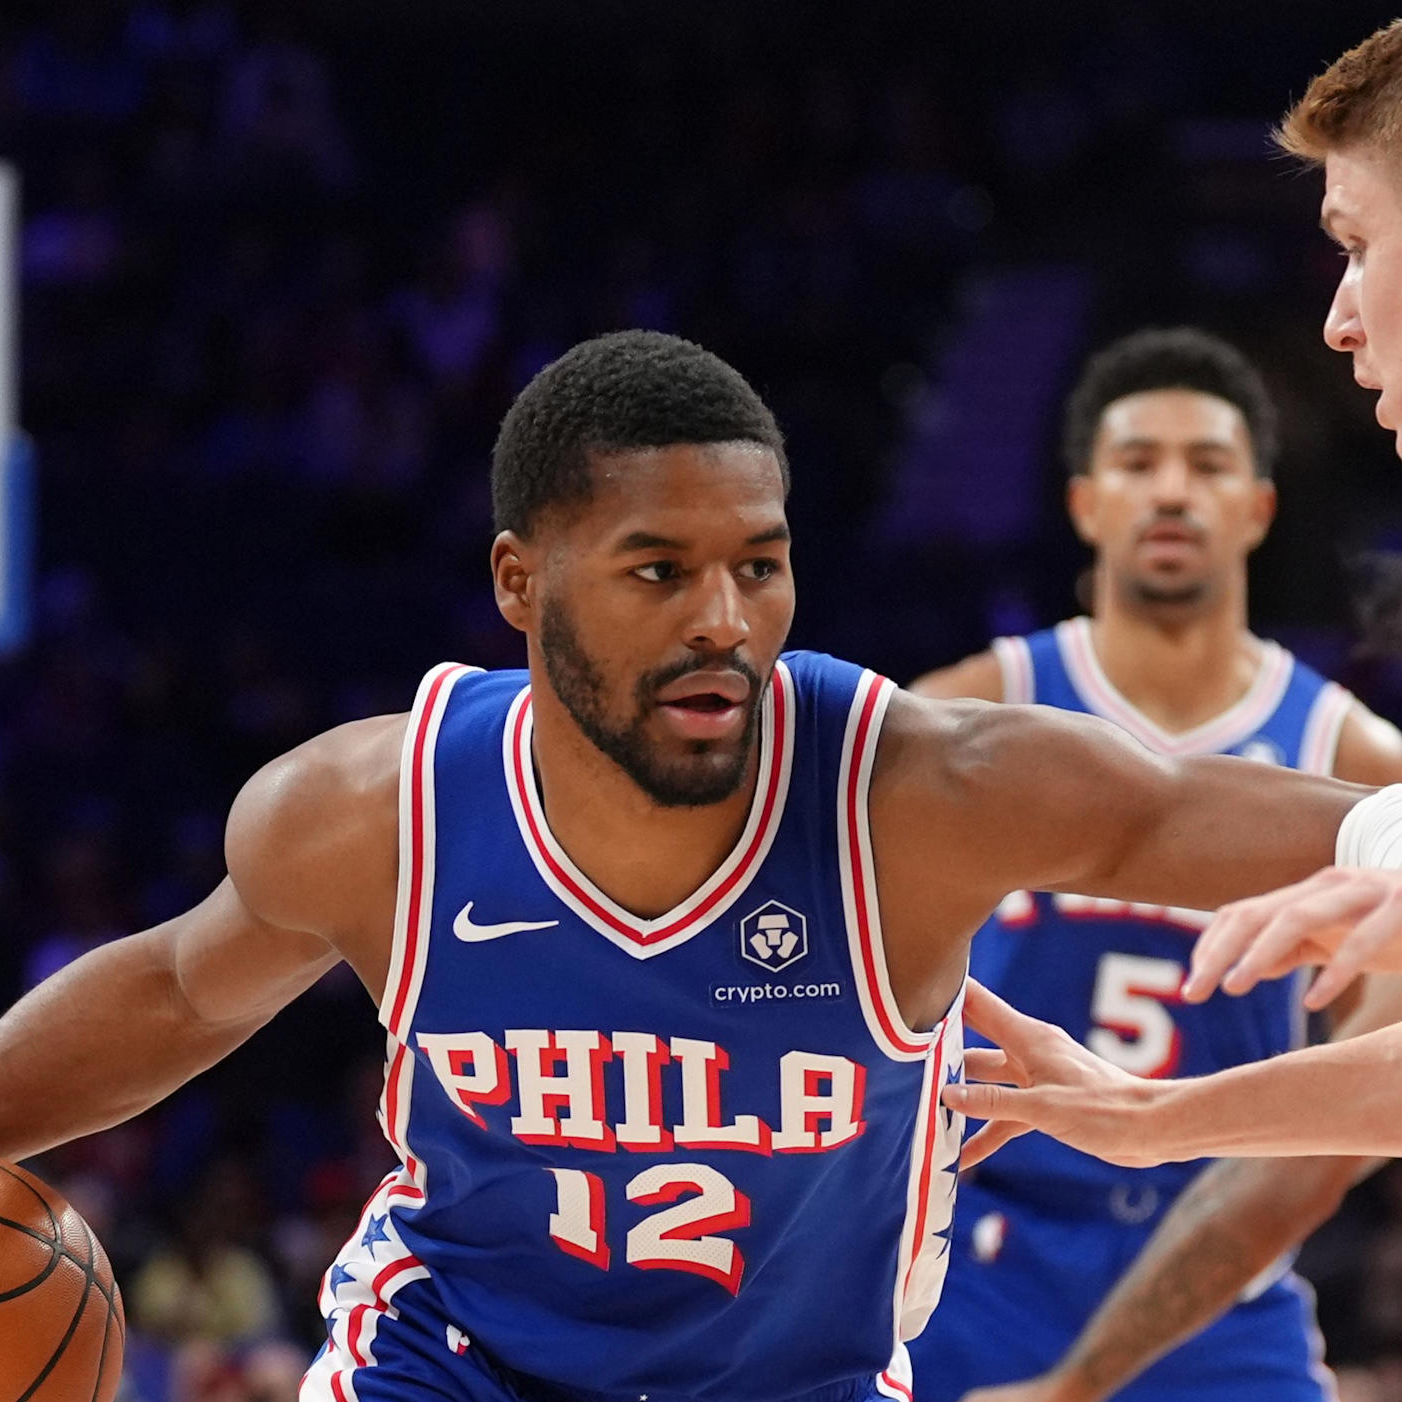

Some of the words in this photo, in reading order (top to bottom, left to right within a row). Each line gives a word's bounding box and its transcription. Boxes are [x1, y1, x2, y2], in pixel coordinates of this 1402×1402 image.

[714, 983, 840, 1003] crypto.com
[1089, 951, 1188, 1079] 5
[415, 1029, 867, 1156] PHILA
[543, 1162, 750, 1296] 12
